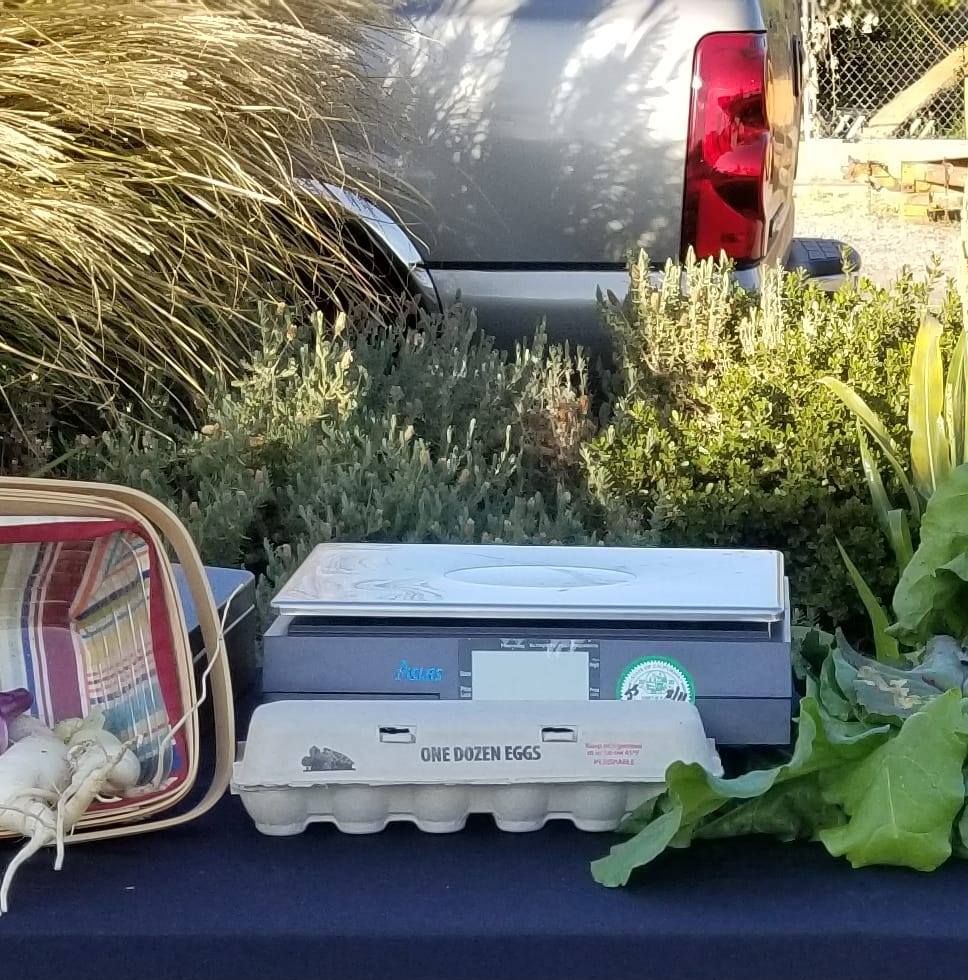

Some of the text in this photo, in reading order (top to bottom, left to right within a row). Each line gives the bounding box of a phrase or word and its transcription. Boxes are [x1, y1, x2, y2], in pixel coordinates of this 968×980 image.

[420, 745, 542, 762] ONE DOZEN EGGS
